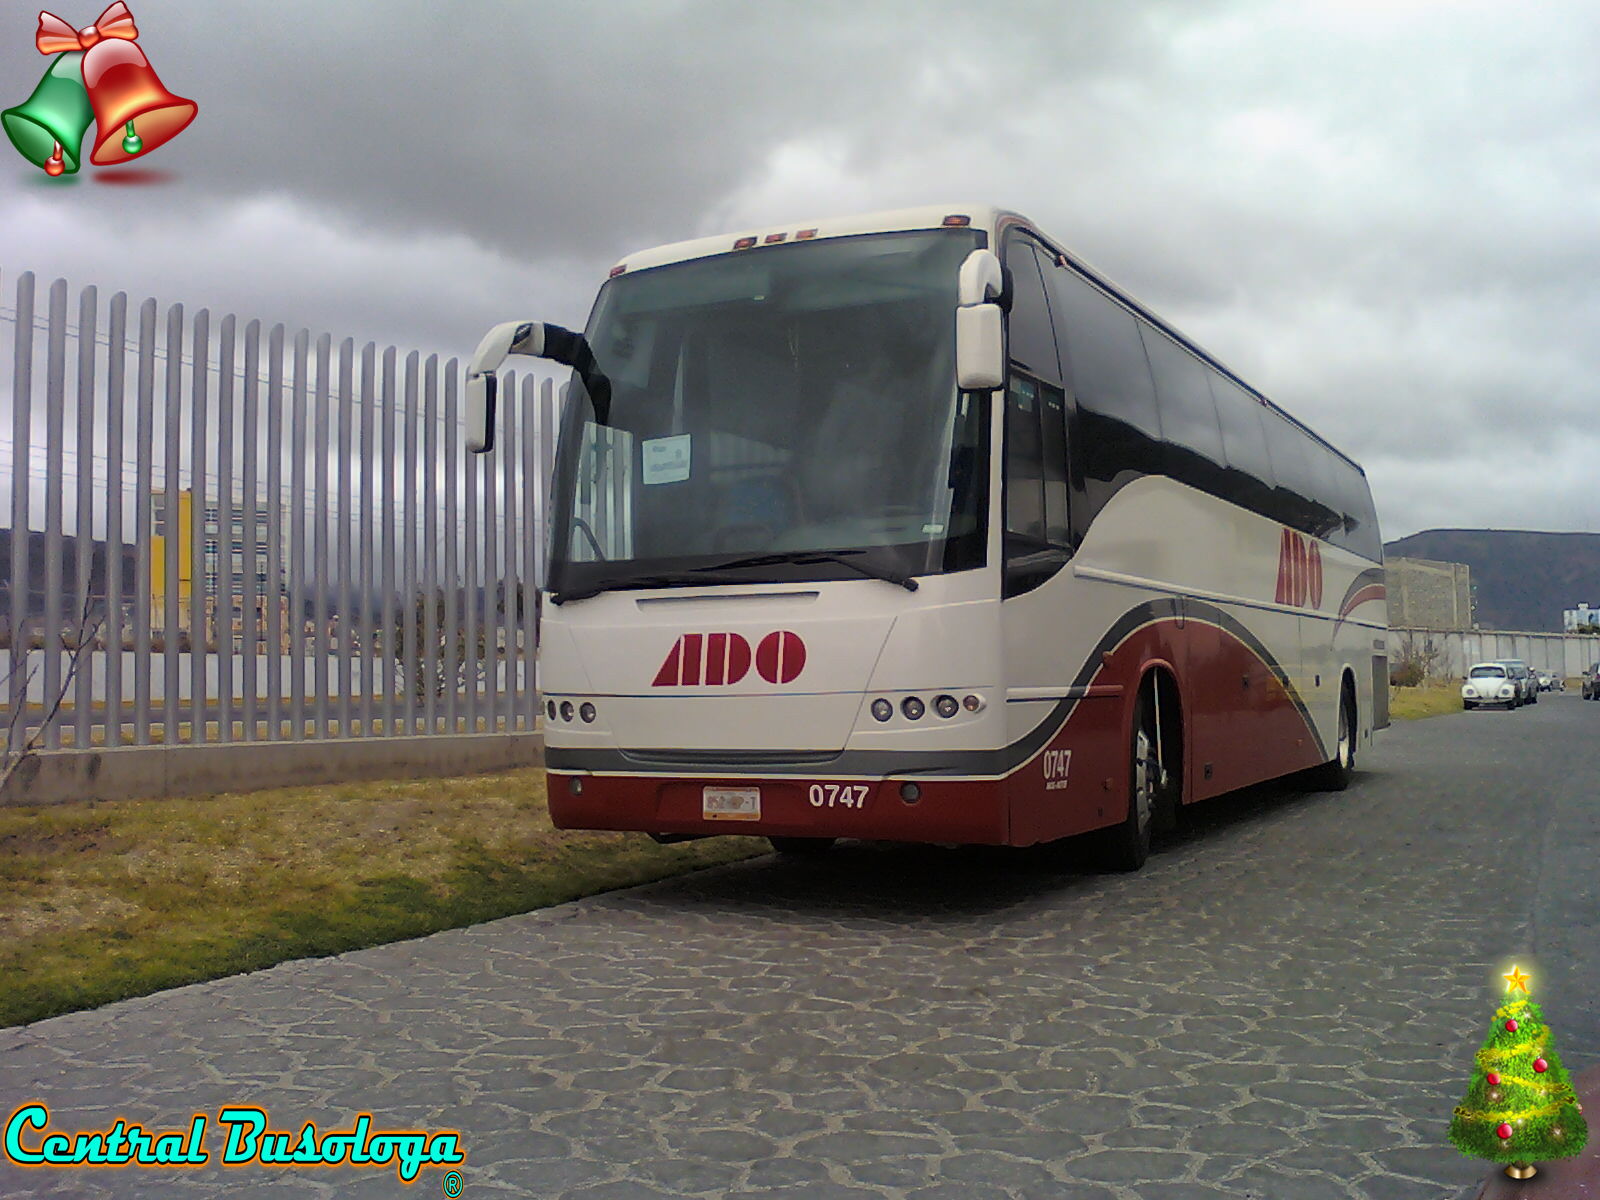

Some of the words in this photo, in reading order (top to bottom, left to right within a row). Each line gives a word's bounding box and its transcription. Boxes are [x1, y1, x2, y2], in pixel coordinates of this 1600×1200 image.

[1274, 527, 1323, 610] ADO
[651, 630, 807, 687] ADO
[1043, 749, 1072, 779] 0747
[808, 784, 870, 809] 0747
